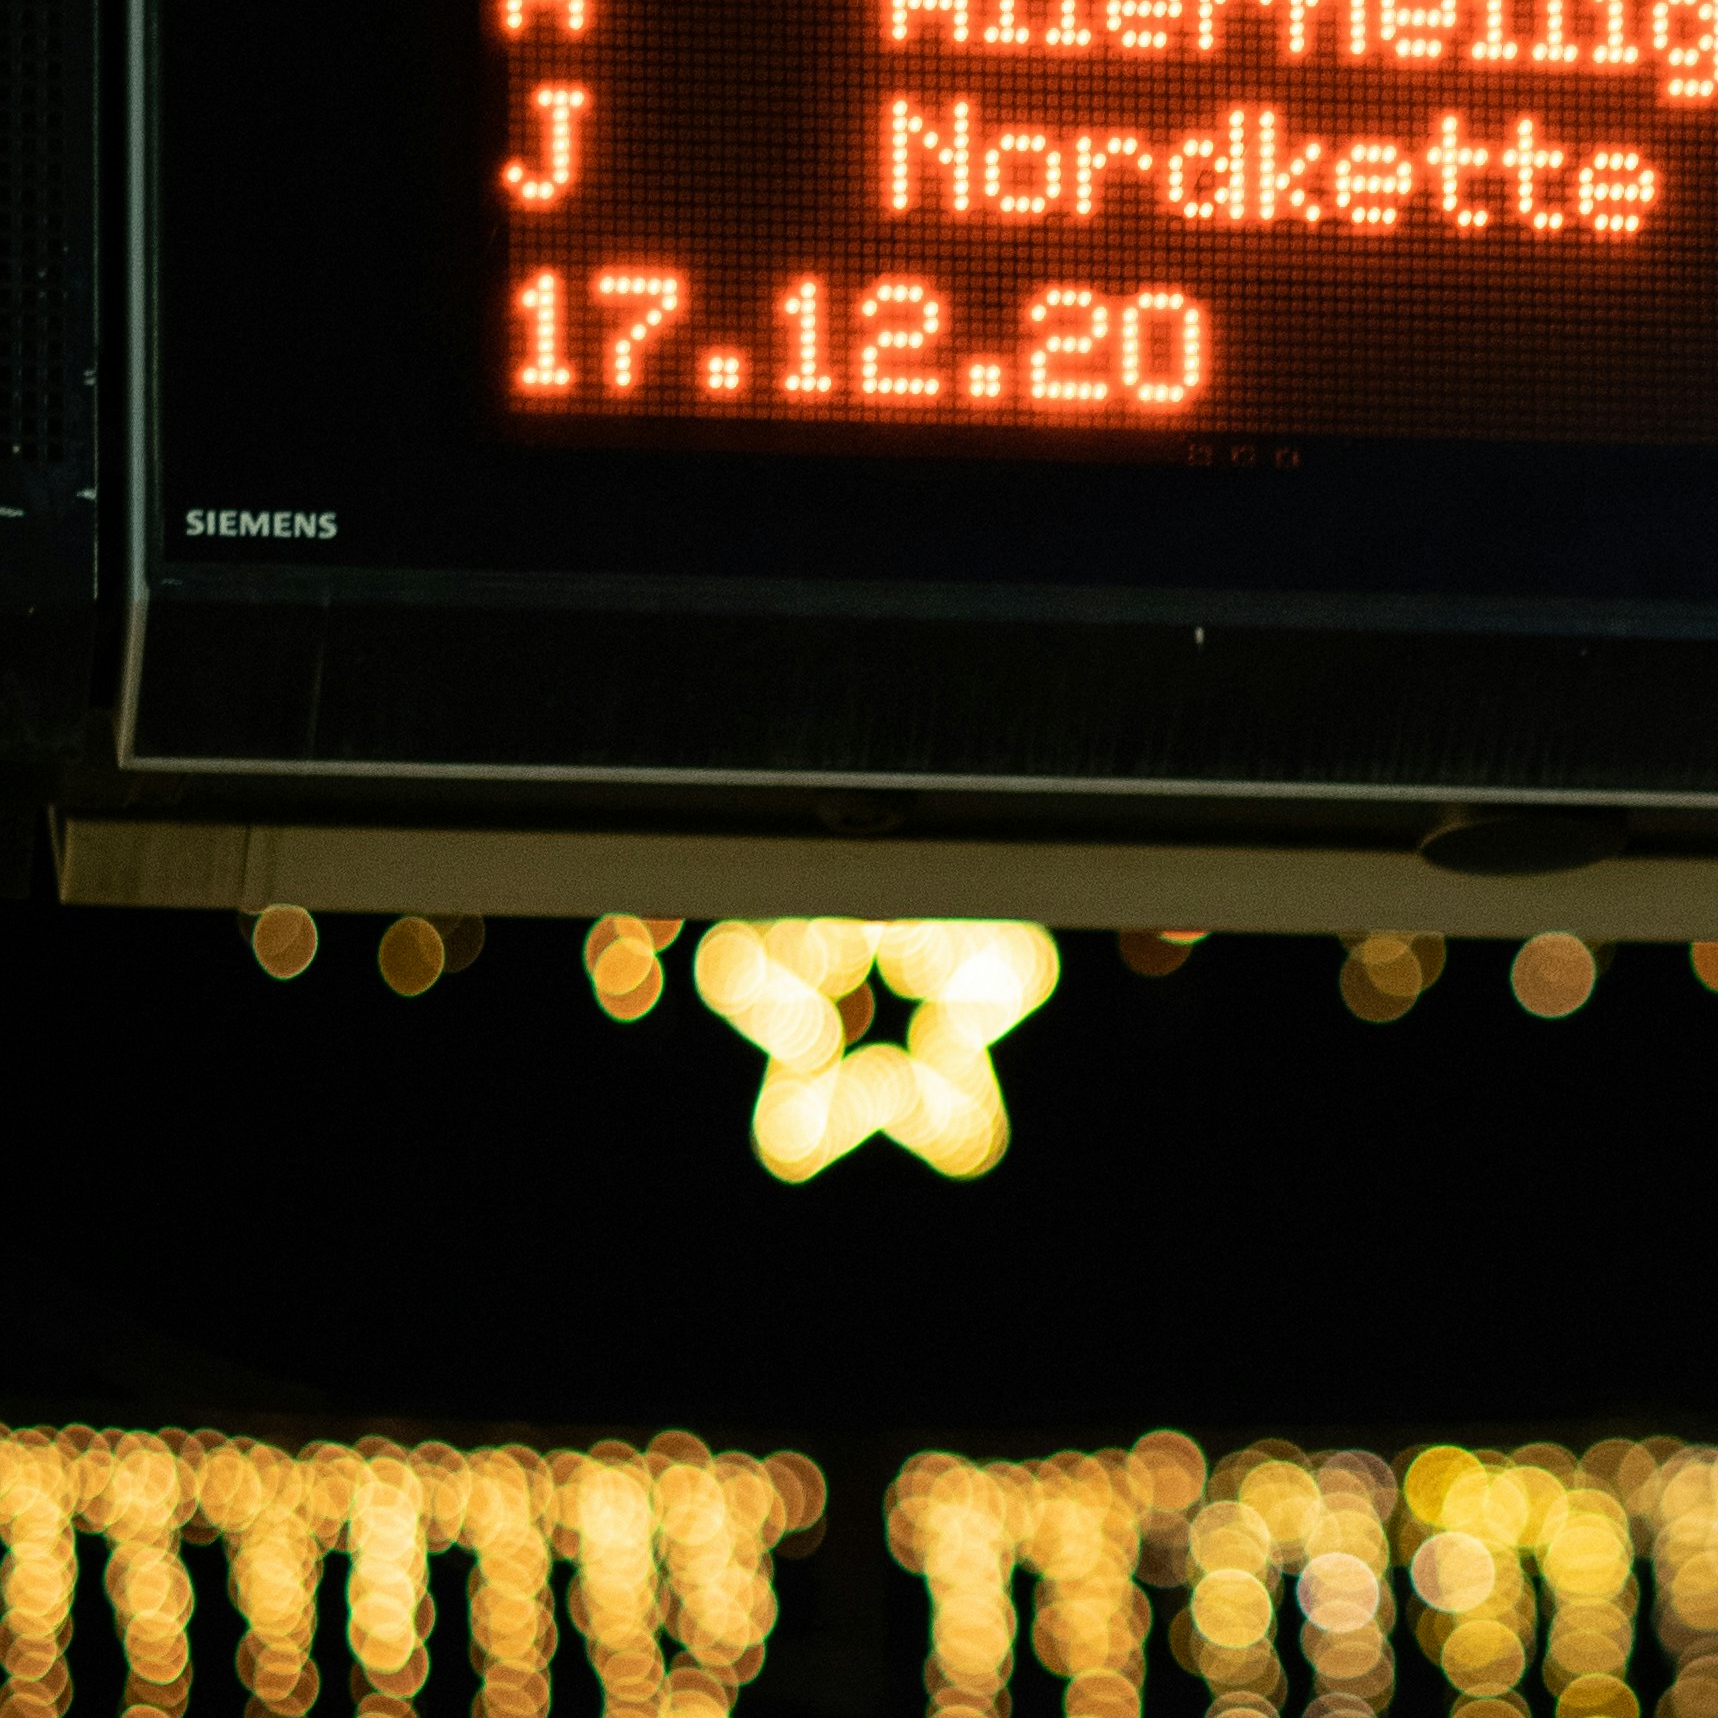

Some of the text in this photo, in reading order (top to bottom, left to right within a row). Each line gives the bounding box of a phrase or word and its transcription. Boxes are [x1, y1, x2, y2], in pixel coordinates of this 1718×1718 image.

[503, 84, 588, 205] J
[888, 98, 1659, 234] Nordkette
[518, 270, 1206, 408] 17.12.20
[185, 508, 338, 540] SIEMENS
